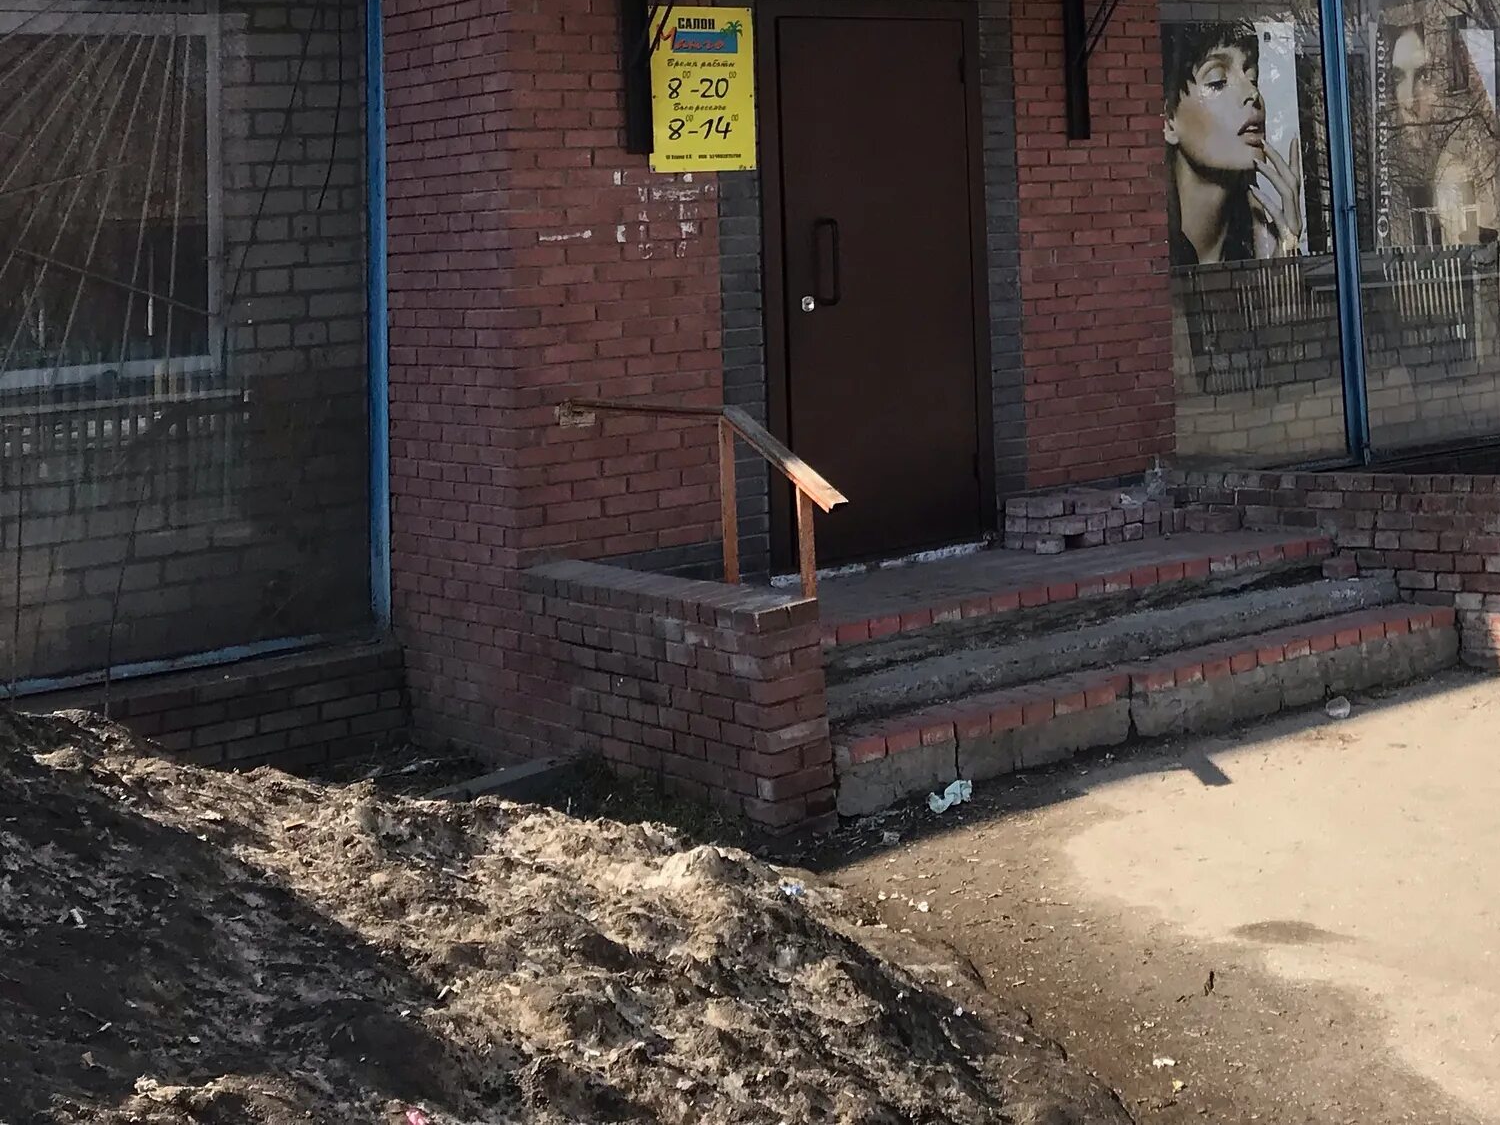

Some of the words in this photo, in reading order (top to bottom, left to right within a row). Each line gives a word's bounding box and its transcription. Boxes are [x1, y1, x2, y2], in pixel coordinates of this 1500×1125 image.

[677, 17, 715, 30] САЛОН
[667, 58, 698, 68] Время
[700, 58, 736, 69] работы
